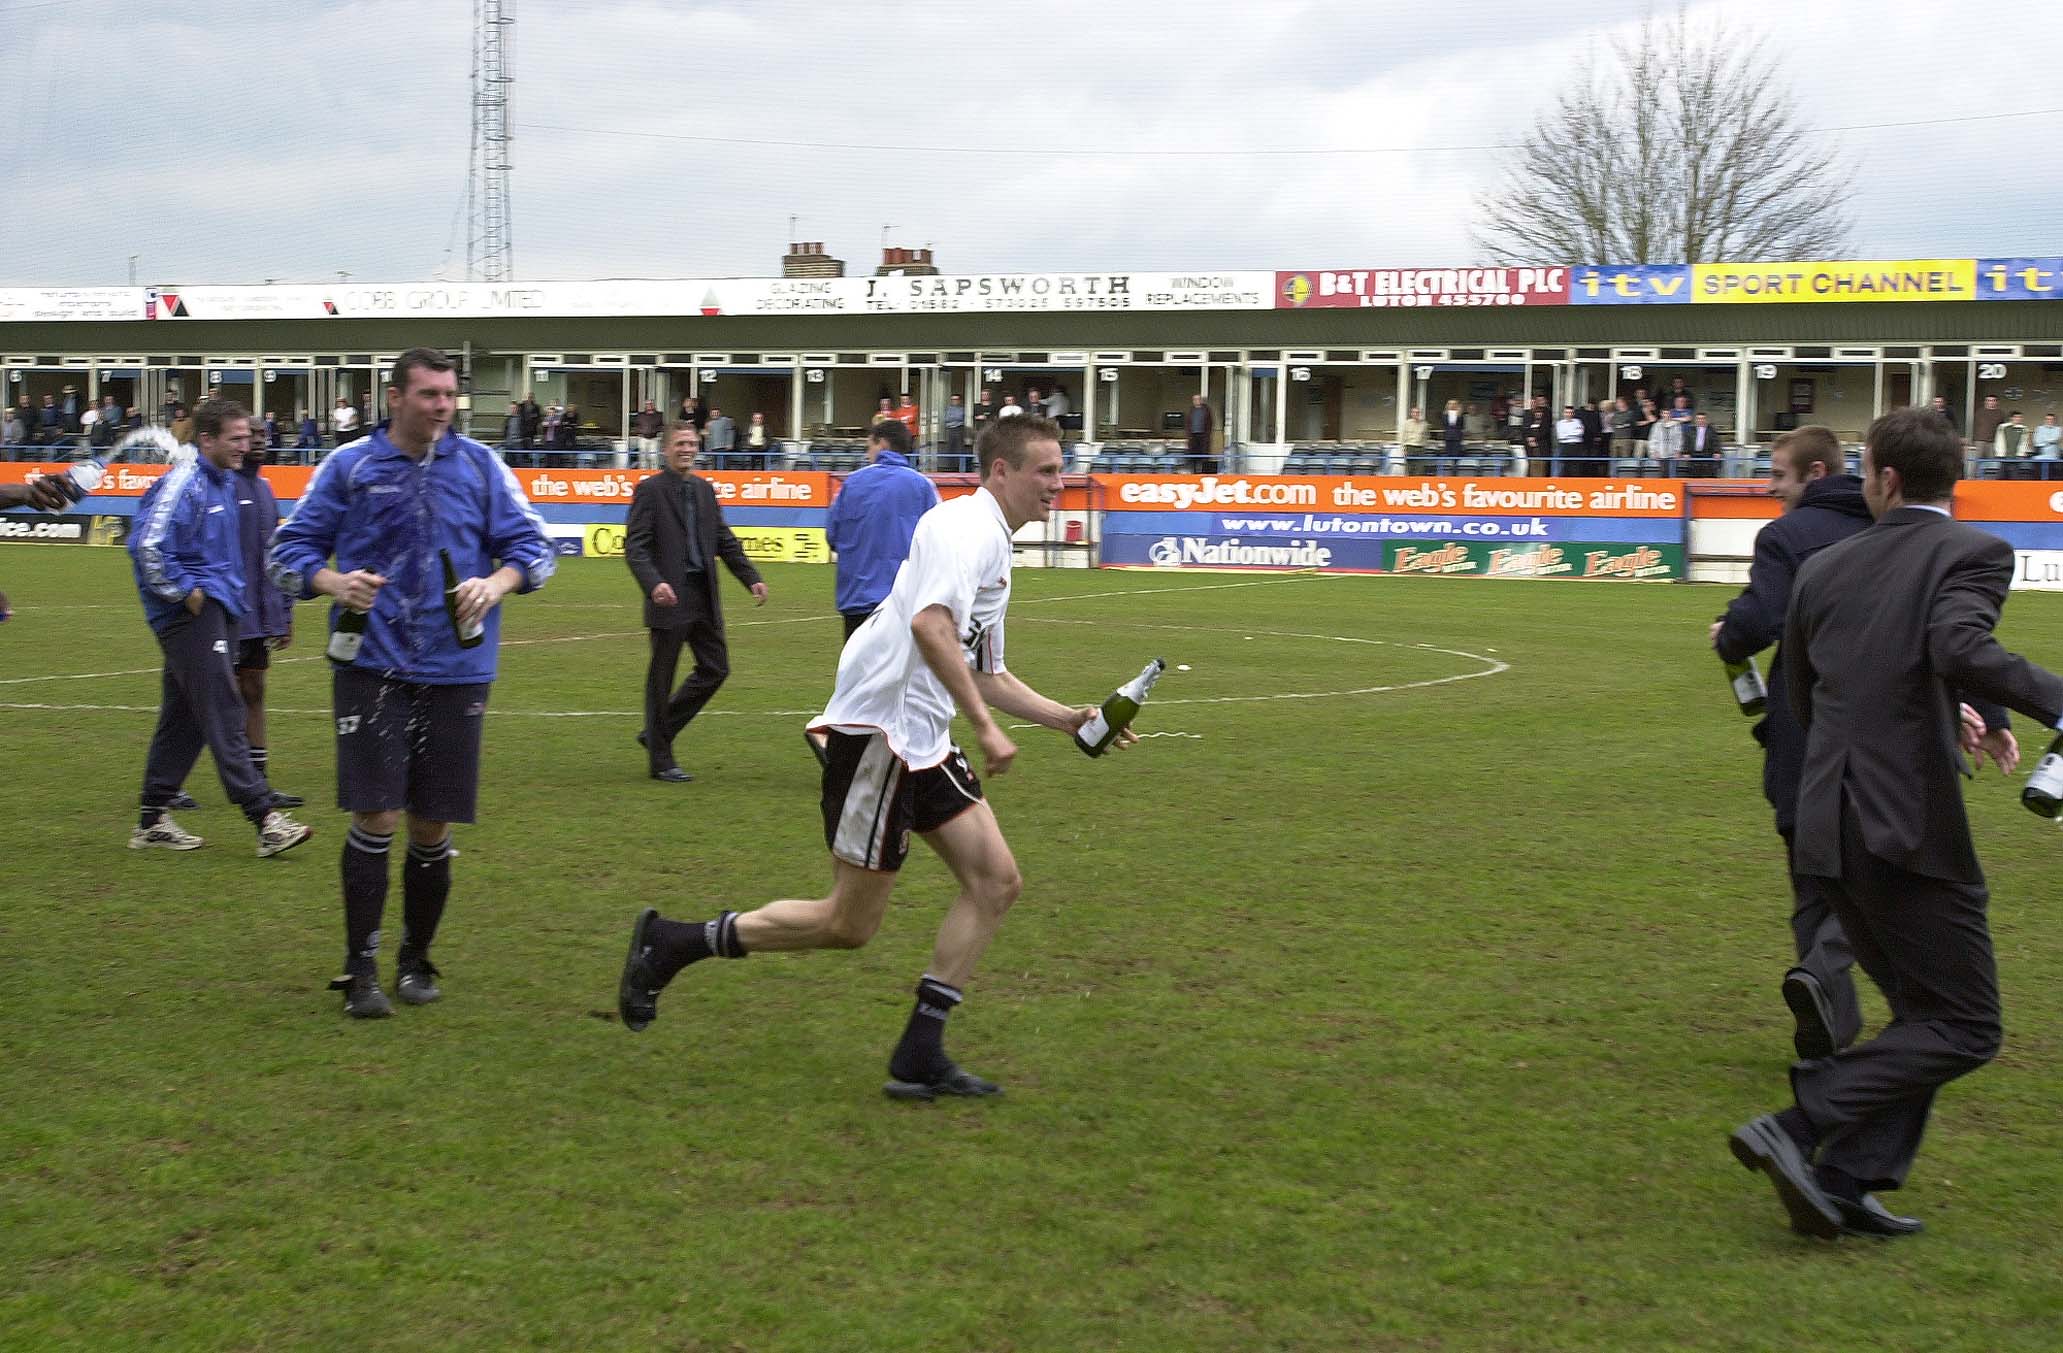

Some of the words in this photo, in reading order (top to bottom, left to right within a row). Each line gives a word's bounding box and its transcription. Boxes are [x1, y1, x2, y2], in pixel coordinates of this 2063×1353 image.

[910, 277, 1130, 297] SAPSWORTH
[1375, 269, 1511, 295] ELECTRICAL
[1518, 268, 1564, 293] PLC
[1579, 271, 1685, 297] itv
[1703, 274, 1804, 295] SPORT
[1812, 271, 1965, 294] CHANNEL
[1984, 264, 2063, 292] it
[100, 370, 113, 383] 7
[1754, 364, 1778, 379] 19
[1978, 363, 2007, 379] 20
[531, 474, 568, 497] the
[572, 474, 633, 497] web's
[741, 476, 812, 500] airline
[1120, 477, 1317, 508] easyJet.com
[1333, 482, 1377, 506] the
[1383, 482, 1457, 508] web's
[1463, 483, 1584, 510] favourite
[1589, 484, 1677, 511] airline
[1221, 514, 1550, 537] www.lutontown.co.uk
[1183, 537, 1332, 567] Nationwide
[1392, 542, 1469, 574] Eagle
[1486, 544, 1565, 576] Eagle
[1582, 546, 1663, 578] Eagle
